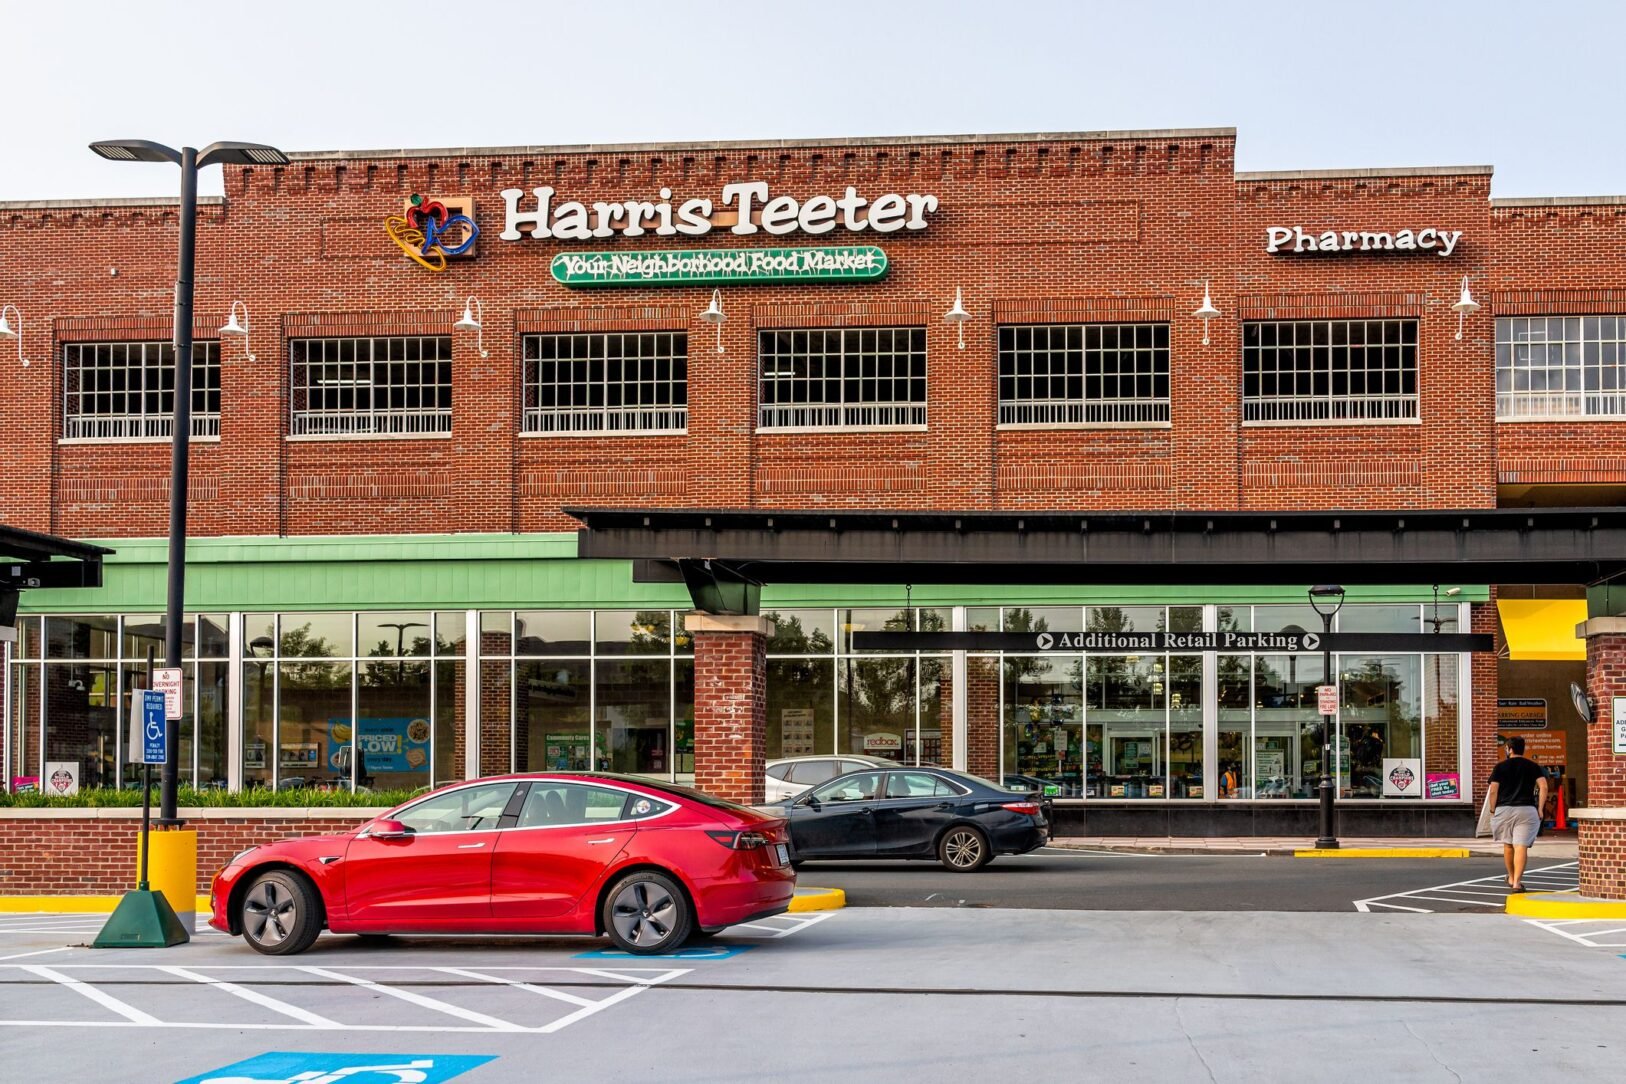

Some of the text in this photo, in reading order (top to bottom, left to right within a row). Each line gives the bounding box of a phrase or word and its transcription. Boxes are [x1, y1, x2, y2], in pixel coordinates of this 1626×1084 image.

[500, 181, 939, 241] Harris Teeter
[1265, 225, 1463, 257] Pharmacy
[562, 250, 876, 278] Your Neighborhood Food Market
[1058, 632, 1298, 650] Additional Retail Parking
[358, 734, 397, 742] PRICED
